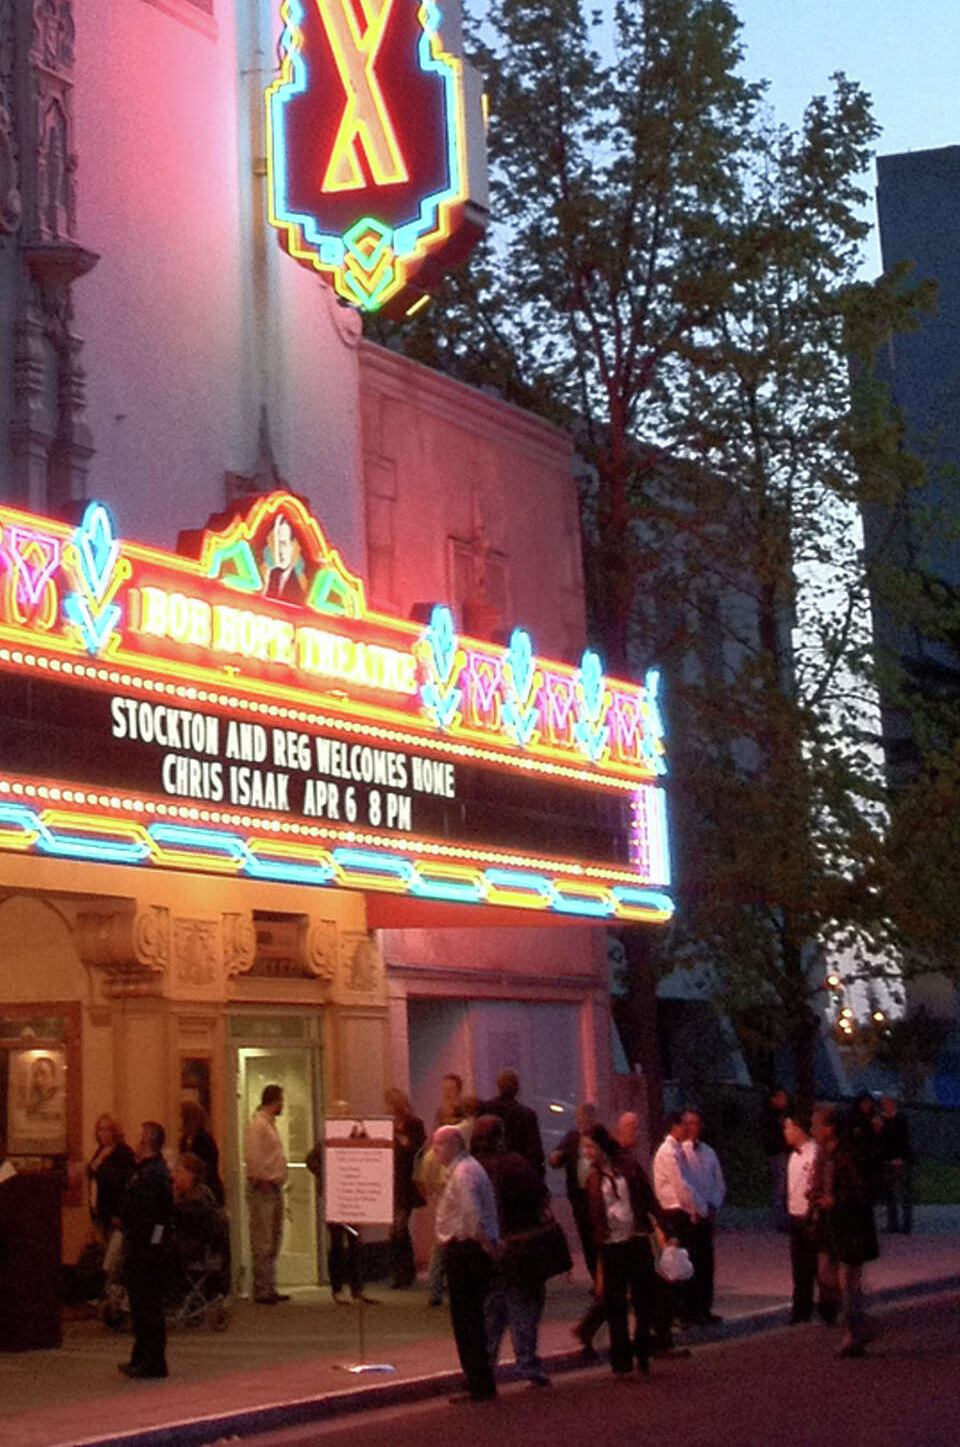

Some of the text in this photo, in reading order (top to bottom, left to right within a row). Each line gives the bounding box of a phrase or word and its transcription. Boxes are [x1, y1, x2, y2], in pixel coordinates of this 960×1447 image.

[140, 586, 418, 695] BOB HOPE THEATRE
[111, 696, 456, 799] STOCKTON AND REG WELCOMES HOME
[162, 753, 412, 831] CHRIS ISAAK APR 6 8 PM
